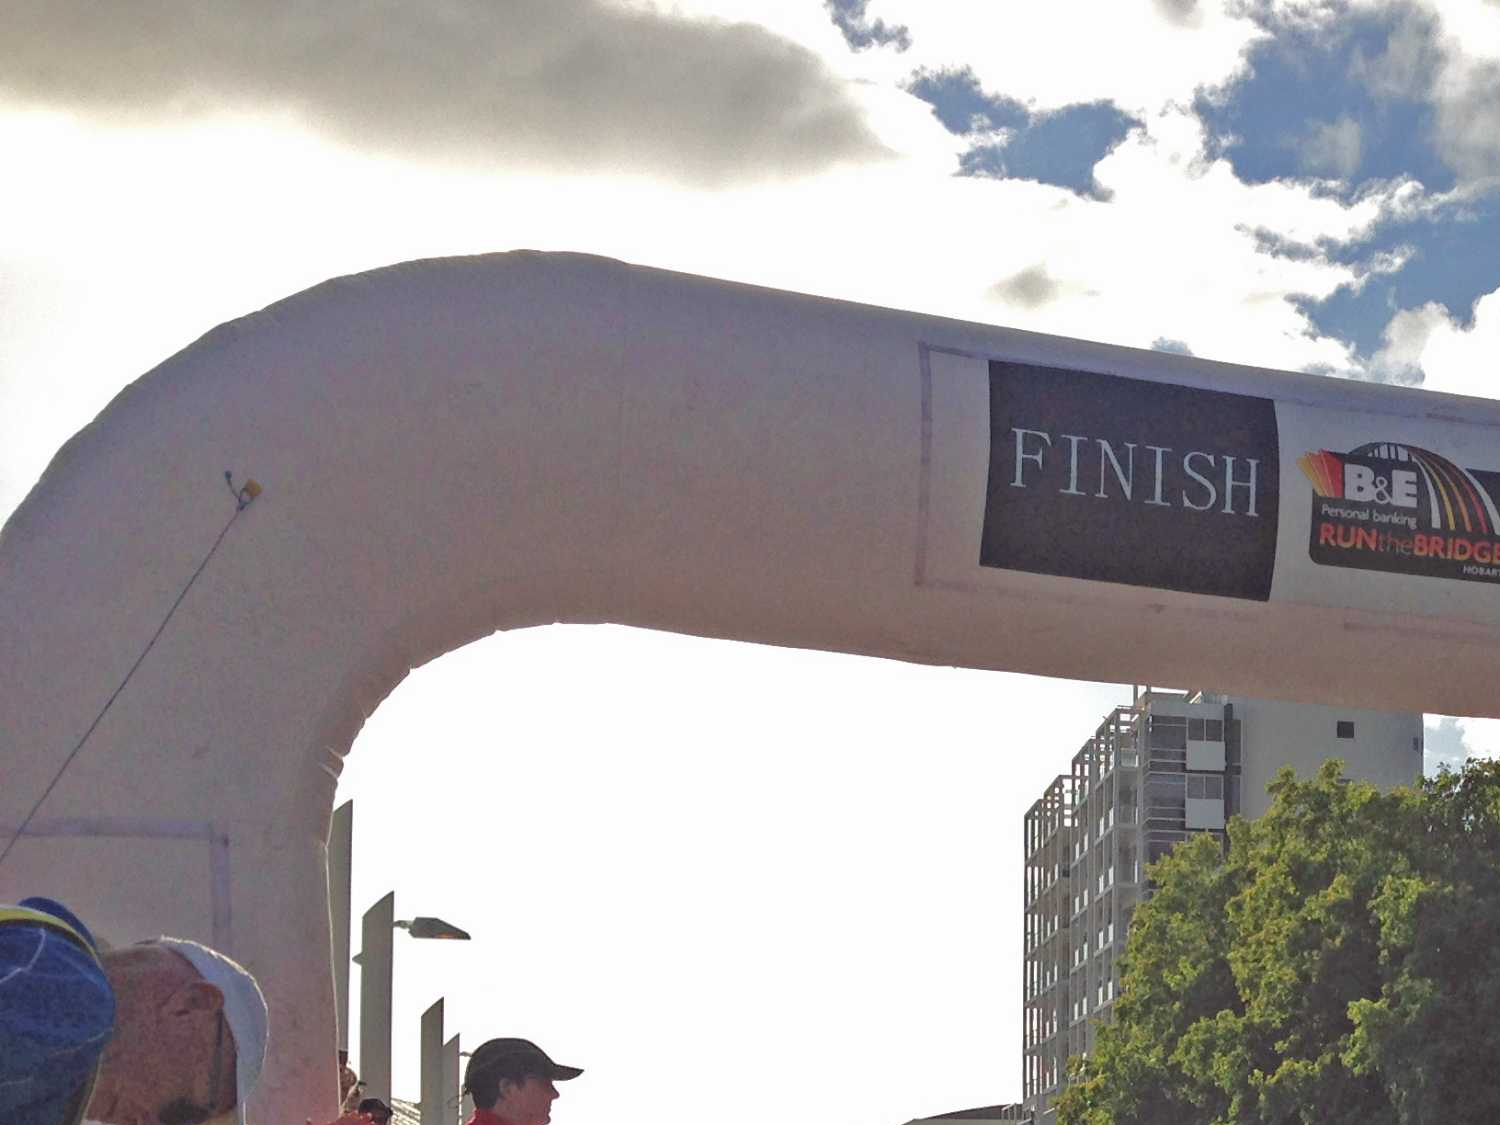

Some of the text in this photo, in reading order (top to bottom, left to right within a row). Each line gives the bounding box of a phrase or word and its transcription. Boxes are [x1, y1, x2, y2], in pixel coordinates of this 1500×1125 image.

[1009, 427, 1262, 517] FINISH
[1344, 463, 1418, 508] B&E
[1321, 503, 1417, 530] Personal banking
